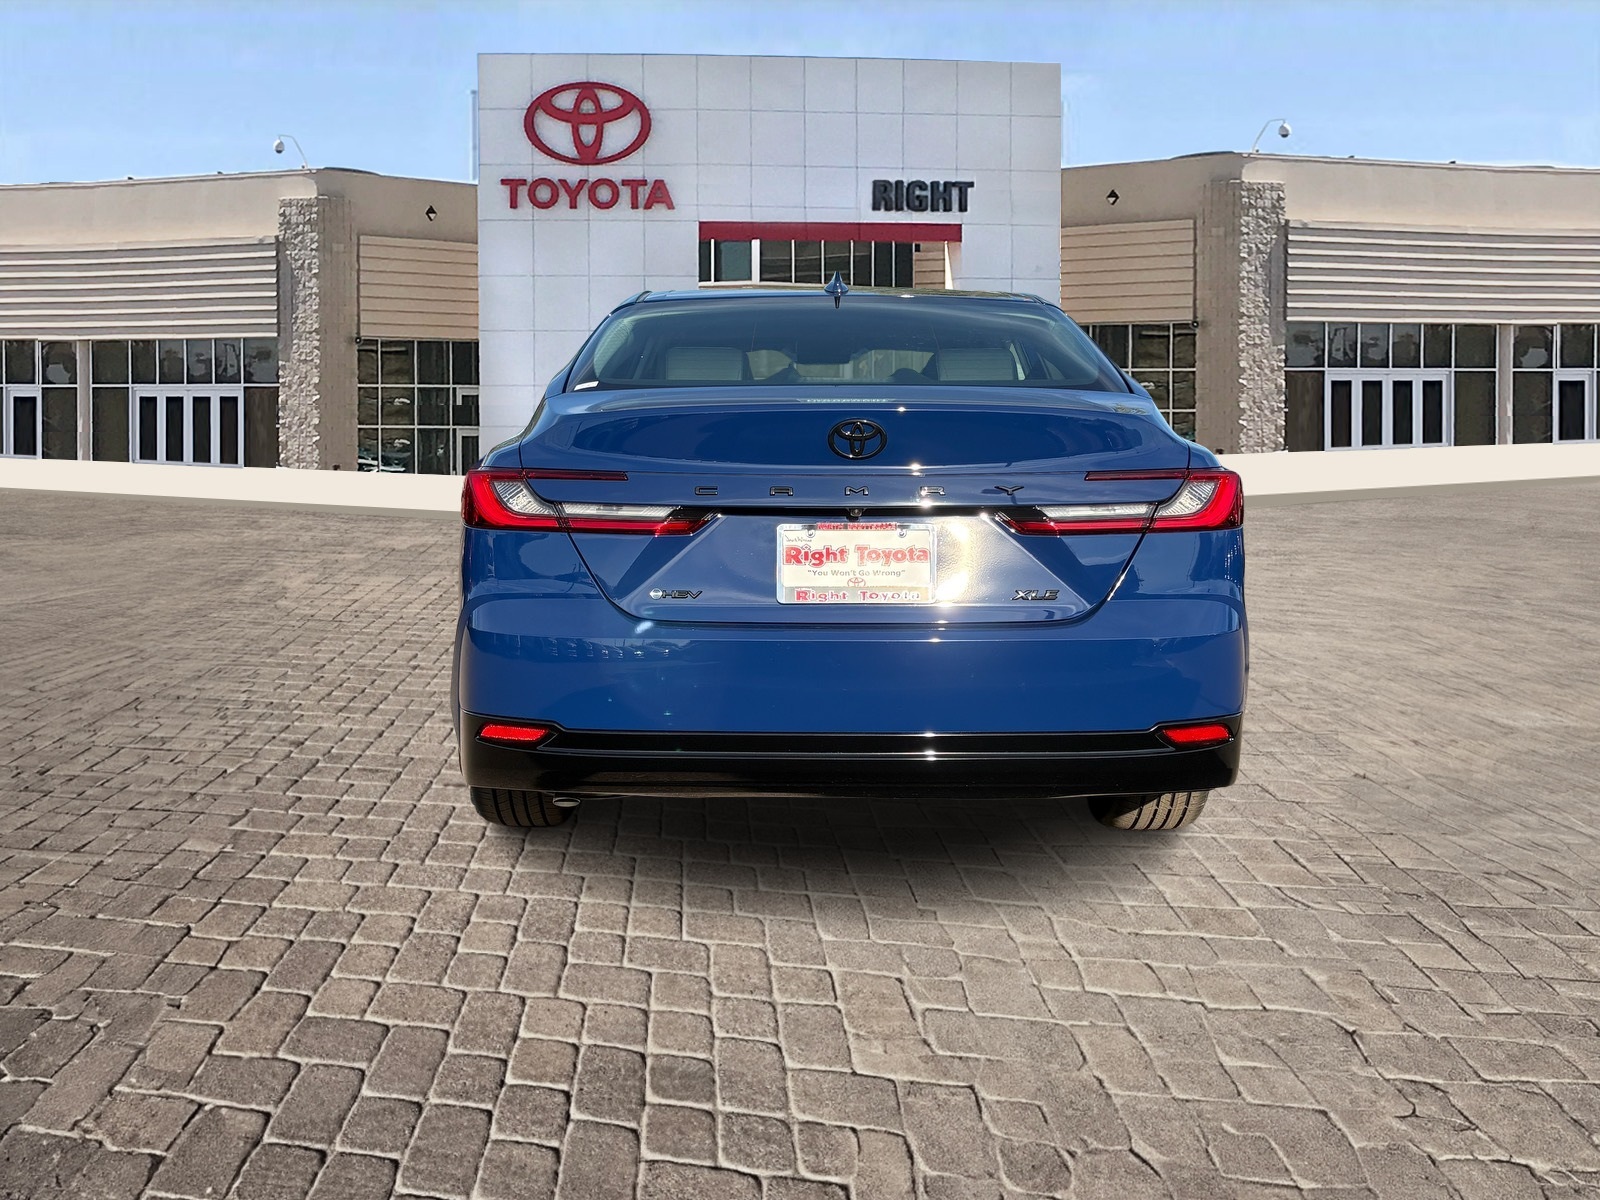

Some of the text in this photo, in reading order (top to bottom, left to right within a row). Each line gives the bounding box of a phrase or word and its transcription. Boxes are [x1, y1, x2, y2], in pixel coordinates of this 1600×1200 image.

[500, 178, 675, 209] TOYOTA
[872, 179, 975, 212] RIGHT
[694, 485, 1024, 496] CAMRY
[783, 544, 930, 568] Right Toyota
[831, 569, 856, 577] Won't
[795, 588, 848, 601] Right
[1010, 589, 1060, 601] XLE
